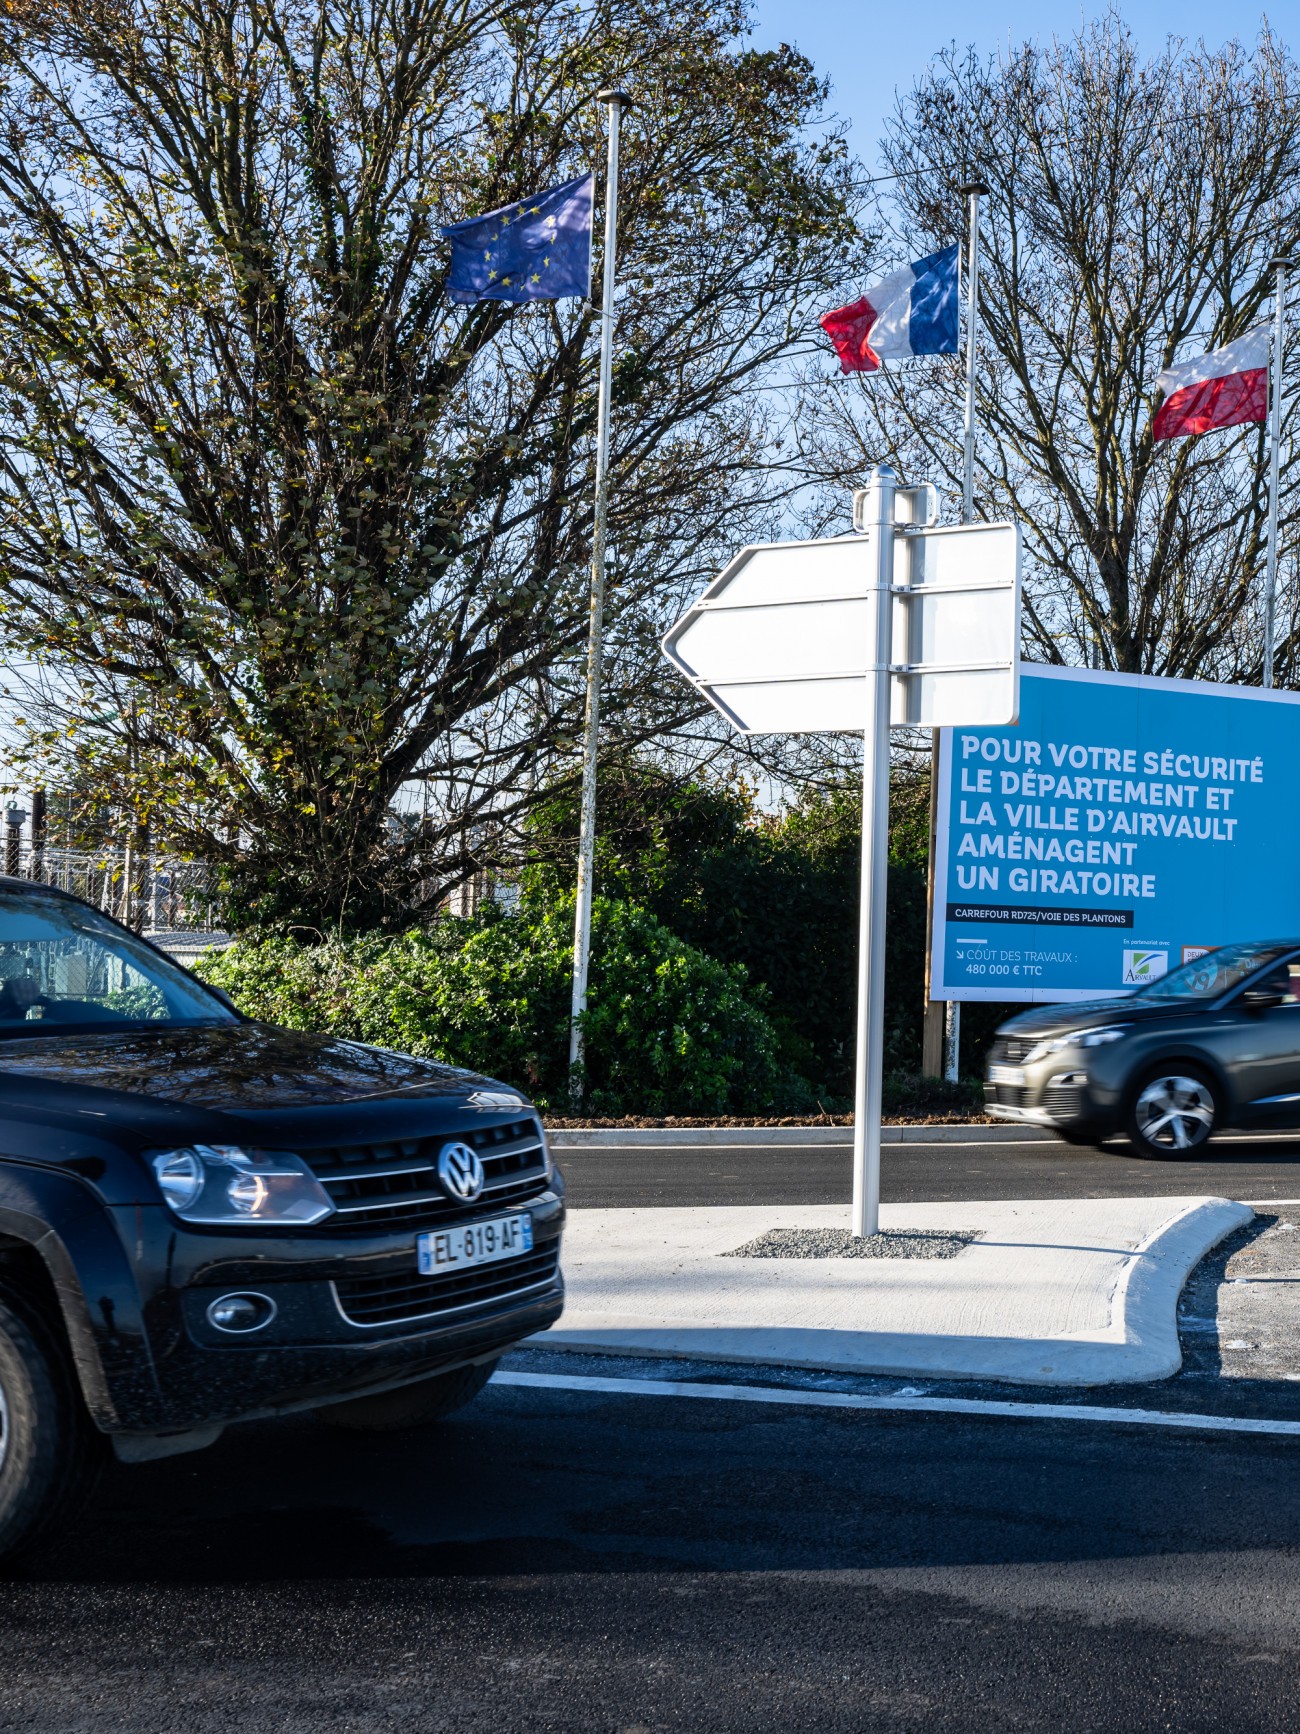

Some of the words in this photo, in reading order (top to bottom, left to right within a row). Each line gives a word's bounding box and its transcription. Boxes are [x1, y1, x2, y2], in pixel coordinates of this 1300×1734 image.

[962, 735, 1041, 765] POUR
[1048, 743, 1136, 773] VOTRE
[1144, 749, 1263, 783] SÉCURITÉ
[961, 768, 992, 793] LE
[1000, 768, 1199, 808] DÉPARTEMENT
[1206, 787, 1234, 811] ET
[960, 800, 997, 826] LA
[1004, 803, 1078, 831] VILLE
[1086, 809, 1238, 841] D'AIRVAULT
[957, 831, 1138, 866] AMÉNAGENT
[957, 865, 998, 890] UN
[1008, 868, 1156, 898] GIRATOIRE
[955, 908, 1010, 920] CARREFOUR
[1011, 910, 1062, 923] RD725/VOIE
[1063, 912, 1080, 922] DES
[1082, 913, 1126, 924] PLANTONS
[966, 947, 997, 962] COÛT
[999, 950, 1021, 962] DES
[1023, 951, 1072, 963] TRAVAUX
[966, 963, 987, 975] 480
[989, 964, 1010, 976] 000
[1012, 964, 1020, 976] €
[1023, 965, 1043, 977] TTC
[434, 1219, 520, 1265] EL-819-AF
